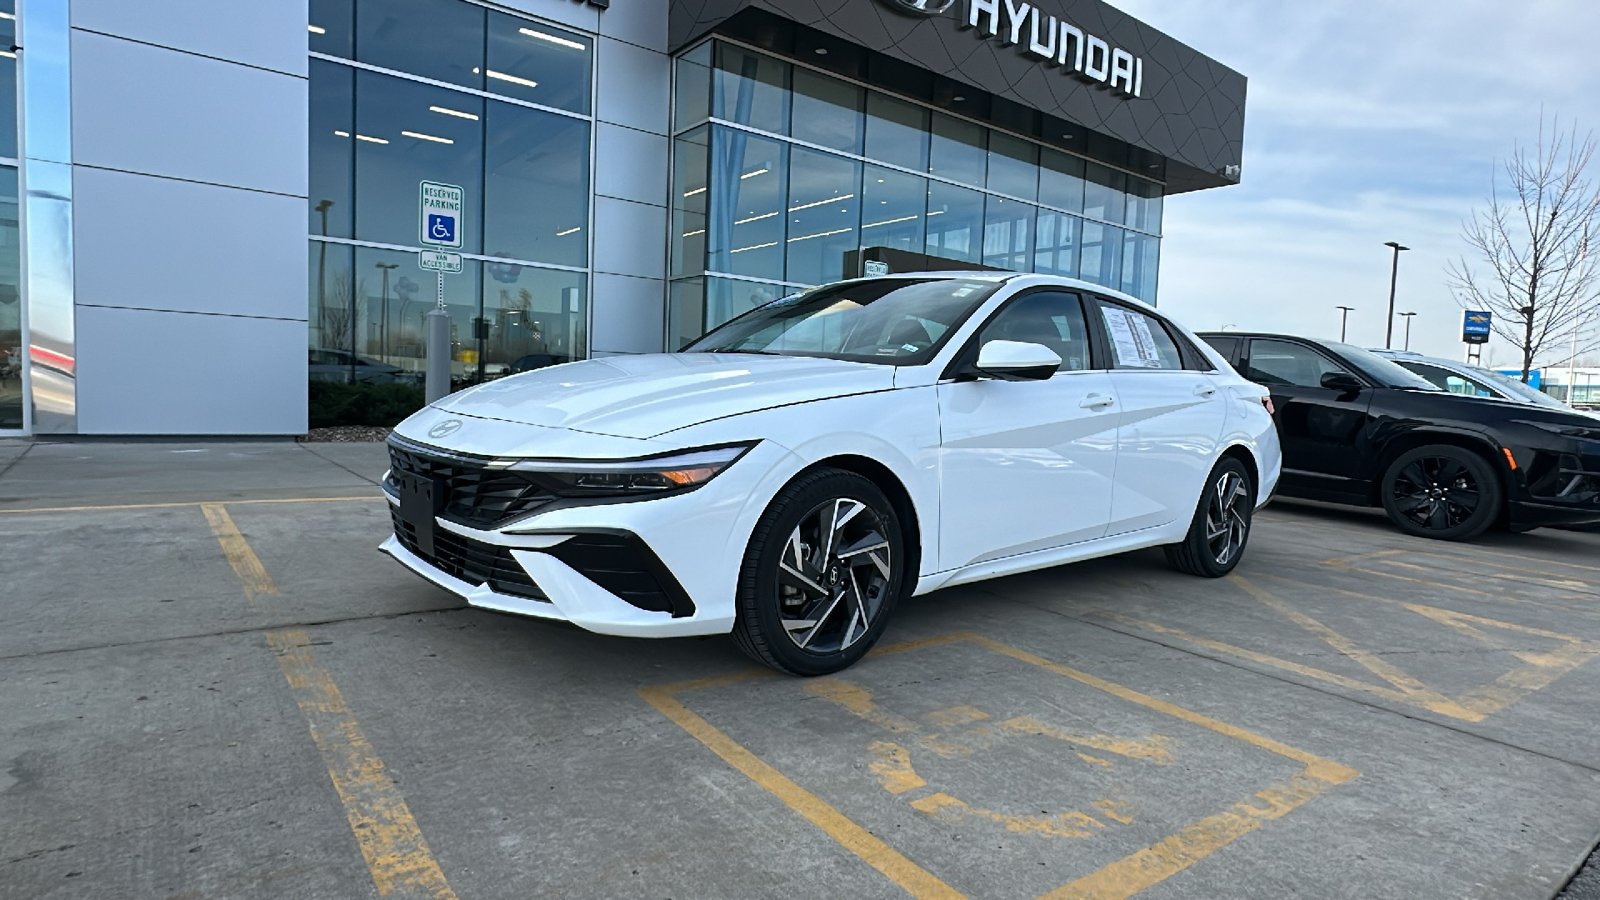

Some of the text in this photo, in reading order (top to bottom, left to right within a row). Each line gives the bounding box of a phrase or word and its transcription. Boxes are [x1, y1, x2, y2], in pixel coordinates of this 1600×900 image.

[968, 0, 1142, 97] HYUNDAI
[424, 187, 459, 201] RESERVED
[424, 198, 459, 211] PARKING
[435, 254, 448, 262] VAN
[423, 260, 460, 270] ACCESSIBLE
